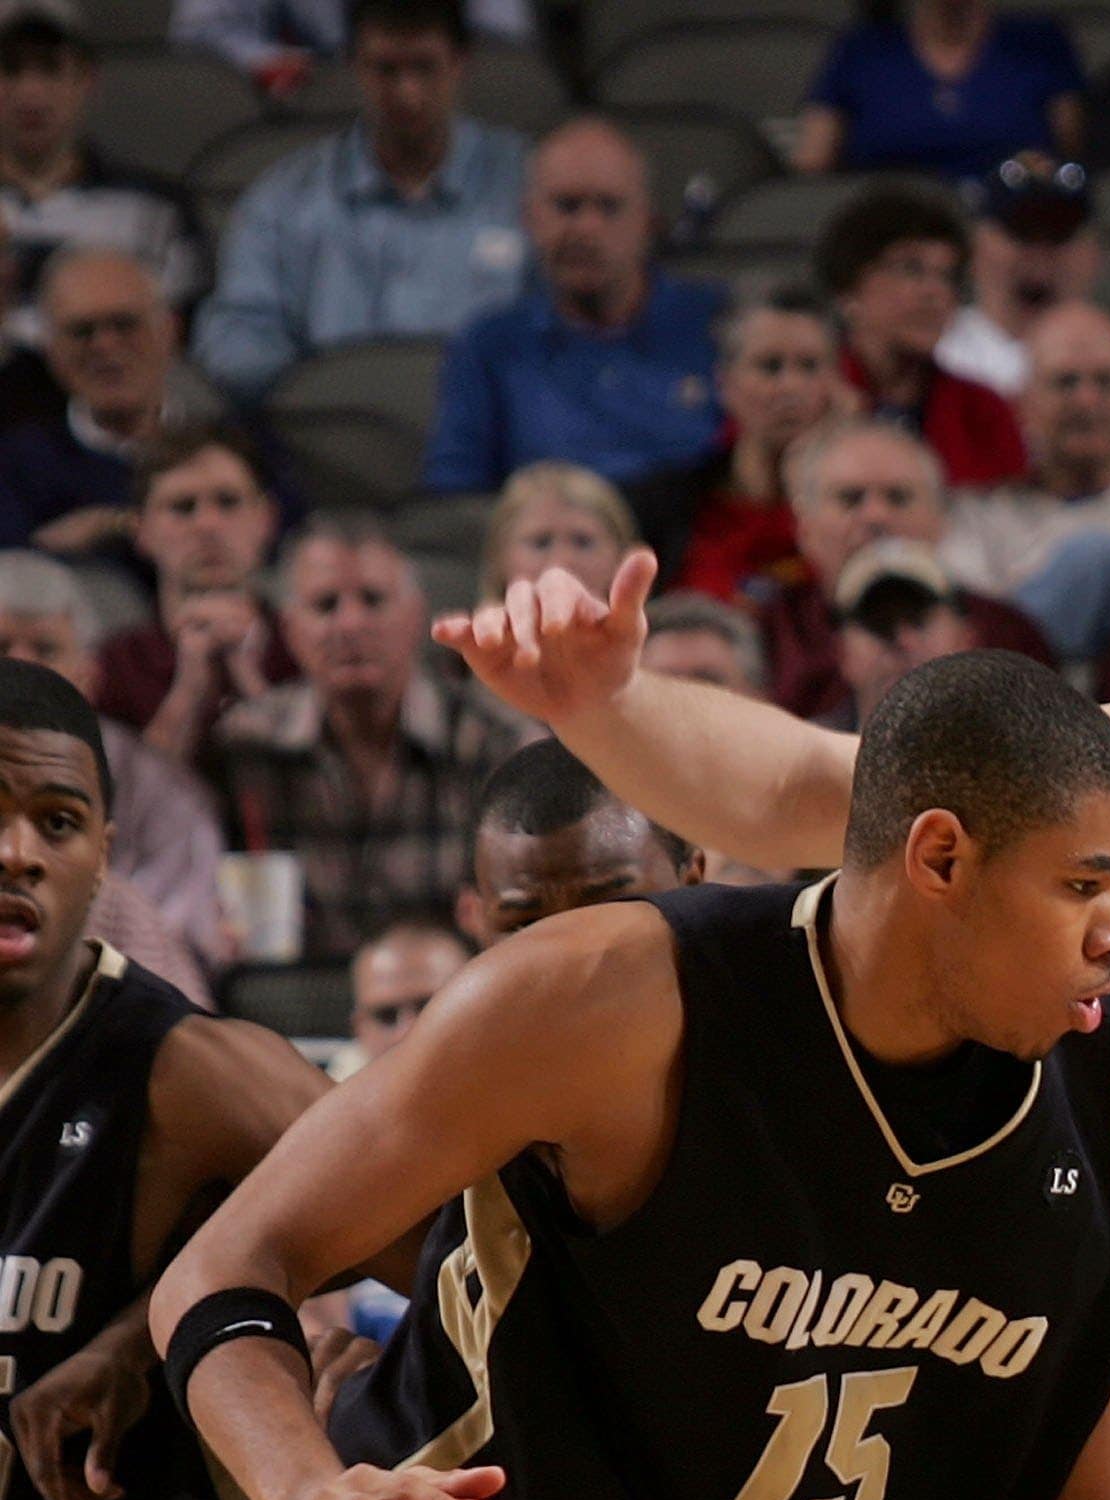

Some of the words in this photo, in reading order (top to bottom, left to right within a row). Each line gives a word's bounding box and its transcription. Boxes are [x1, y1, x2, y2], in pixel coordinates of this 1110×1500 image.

[59, 1121, 94, 1146] LS
[1050, 1168, 1079, 1195] LS
[697, 1259, 1049, 1379] COLORADO
